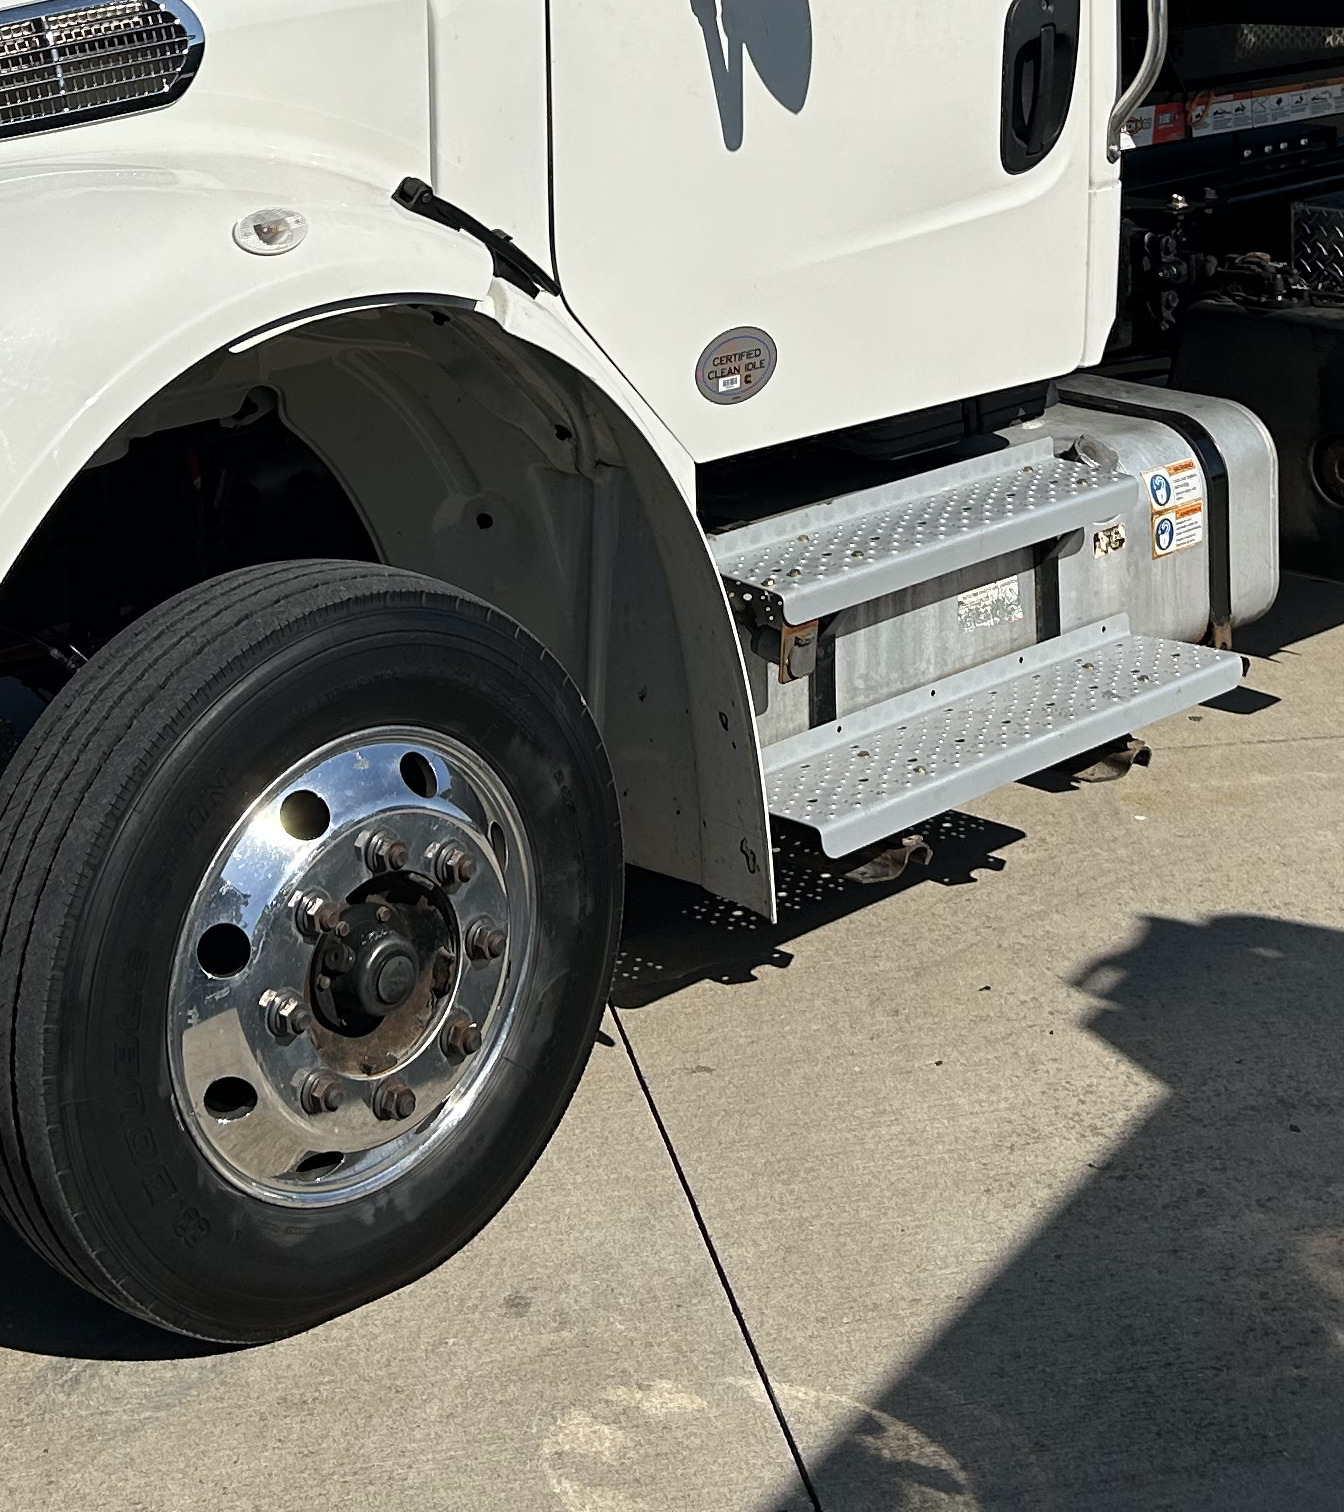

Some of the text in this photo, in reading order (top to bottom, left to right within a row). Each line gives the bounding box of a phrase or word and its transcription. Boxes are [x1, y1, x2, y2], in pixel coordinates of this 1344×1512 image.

[713, 348, 761, 366] CERTIFIED
[708, 360, 765, 380] CLEAN IDLE
